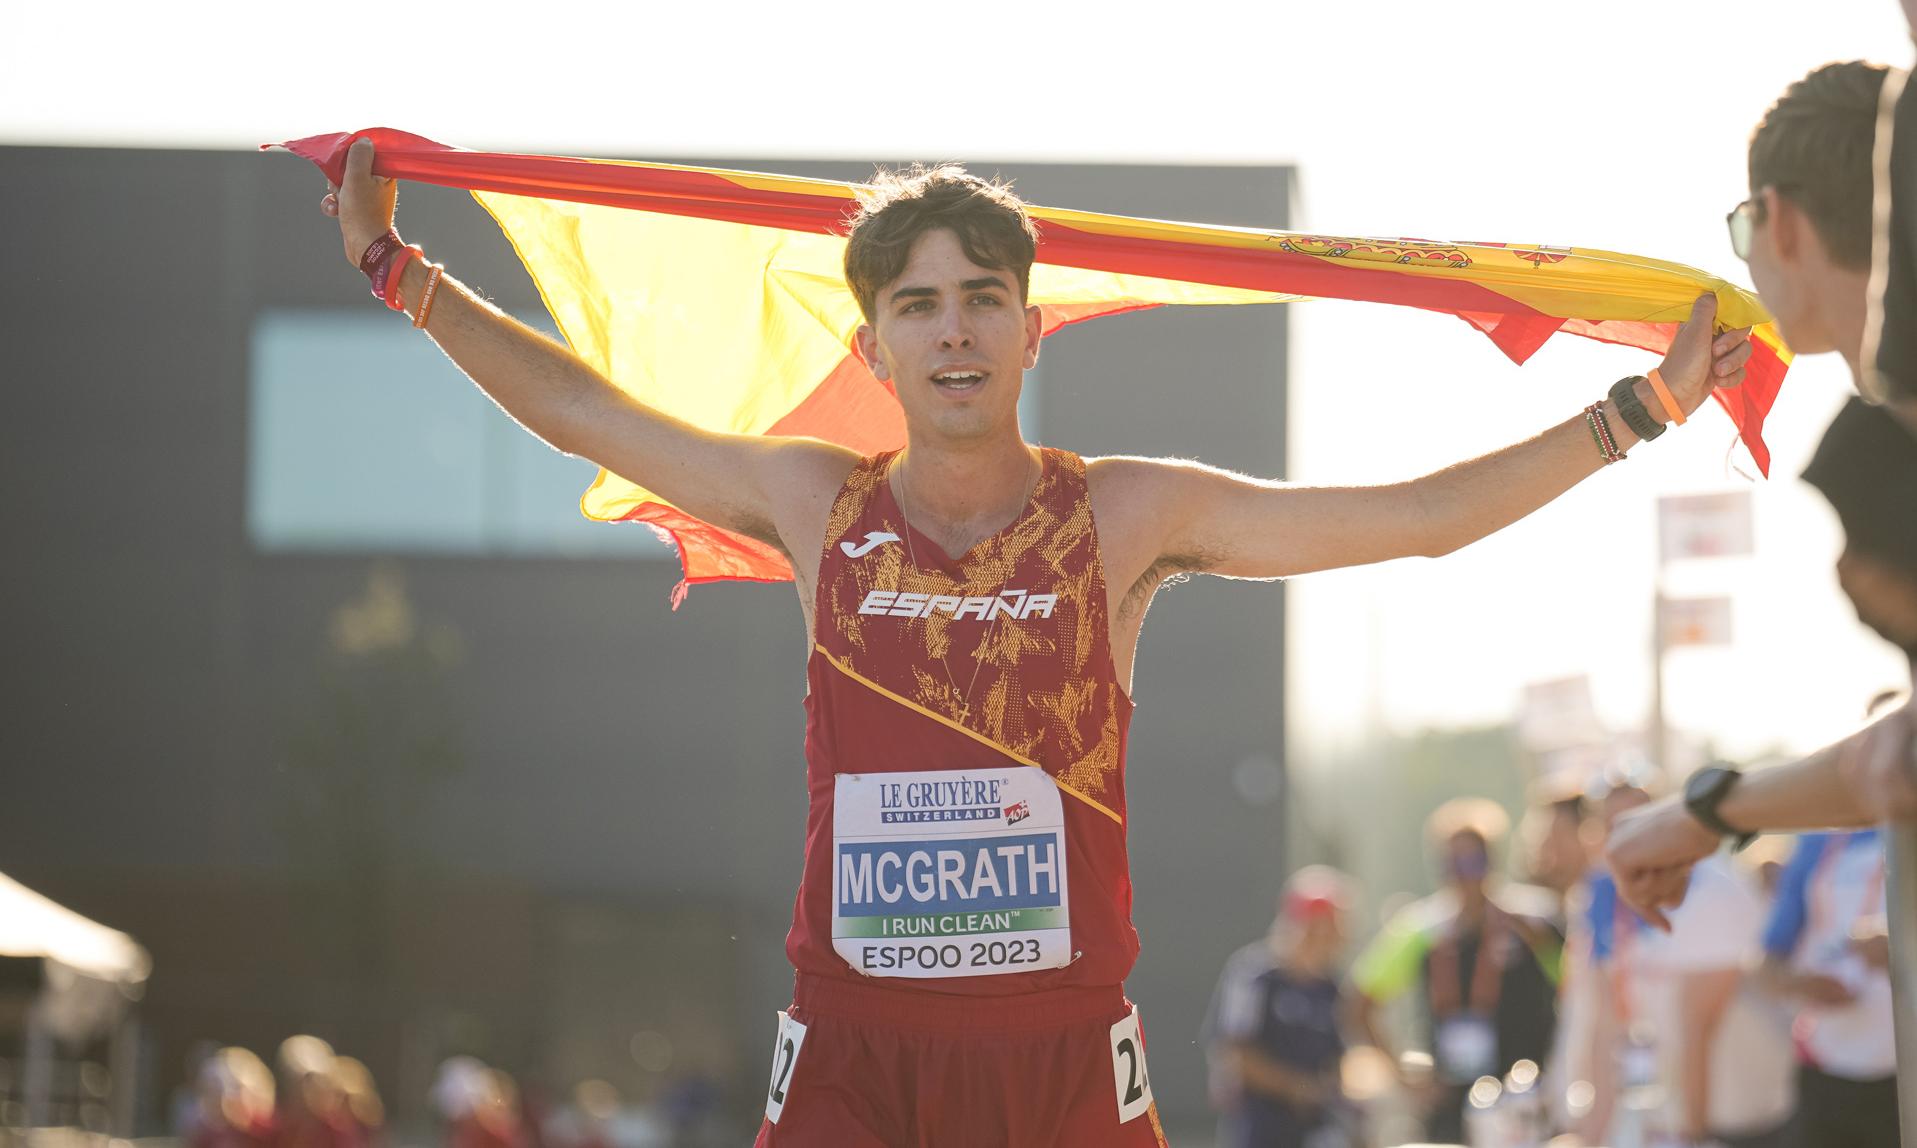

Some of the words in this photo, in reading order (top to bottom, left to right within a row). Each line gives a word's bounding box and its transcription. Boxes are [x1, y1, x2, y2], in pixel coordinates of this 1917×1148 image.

[857, 589, 1058, 621] ESPAÑA
[880, 783, 902, 808] LE
[886, 809, 996, 822] SWITZERLAND
[841, 843, 1057, 904] MCGRATH
[883, 919, 888, 935] I
[892, 916, 935, 935] RUN
[862, 944, 962, 969] ESPOO
[970, 939, 1041, 966] 2023
